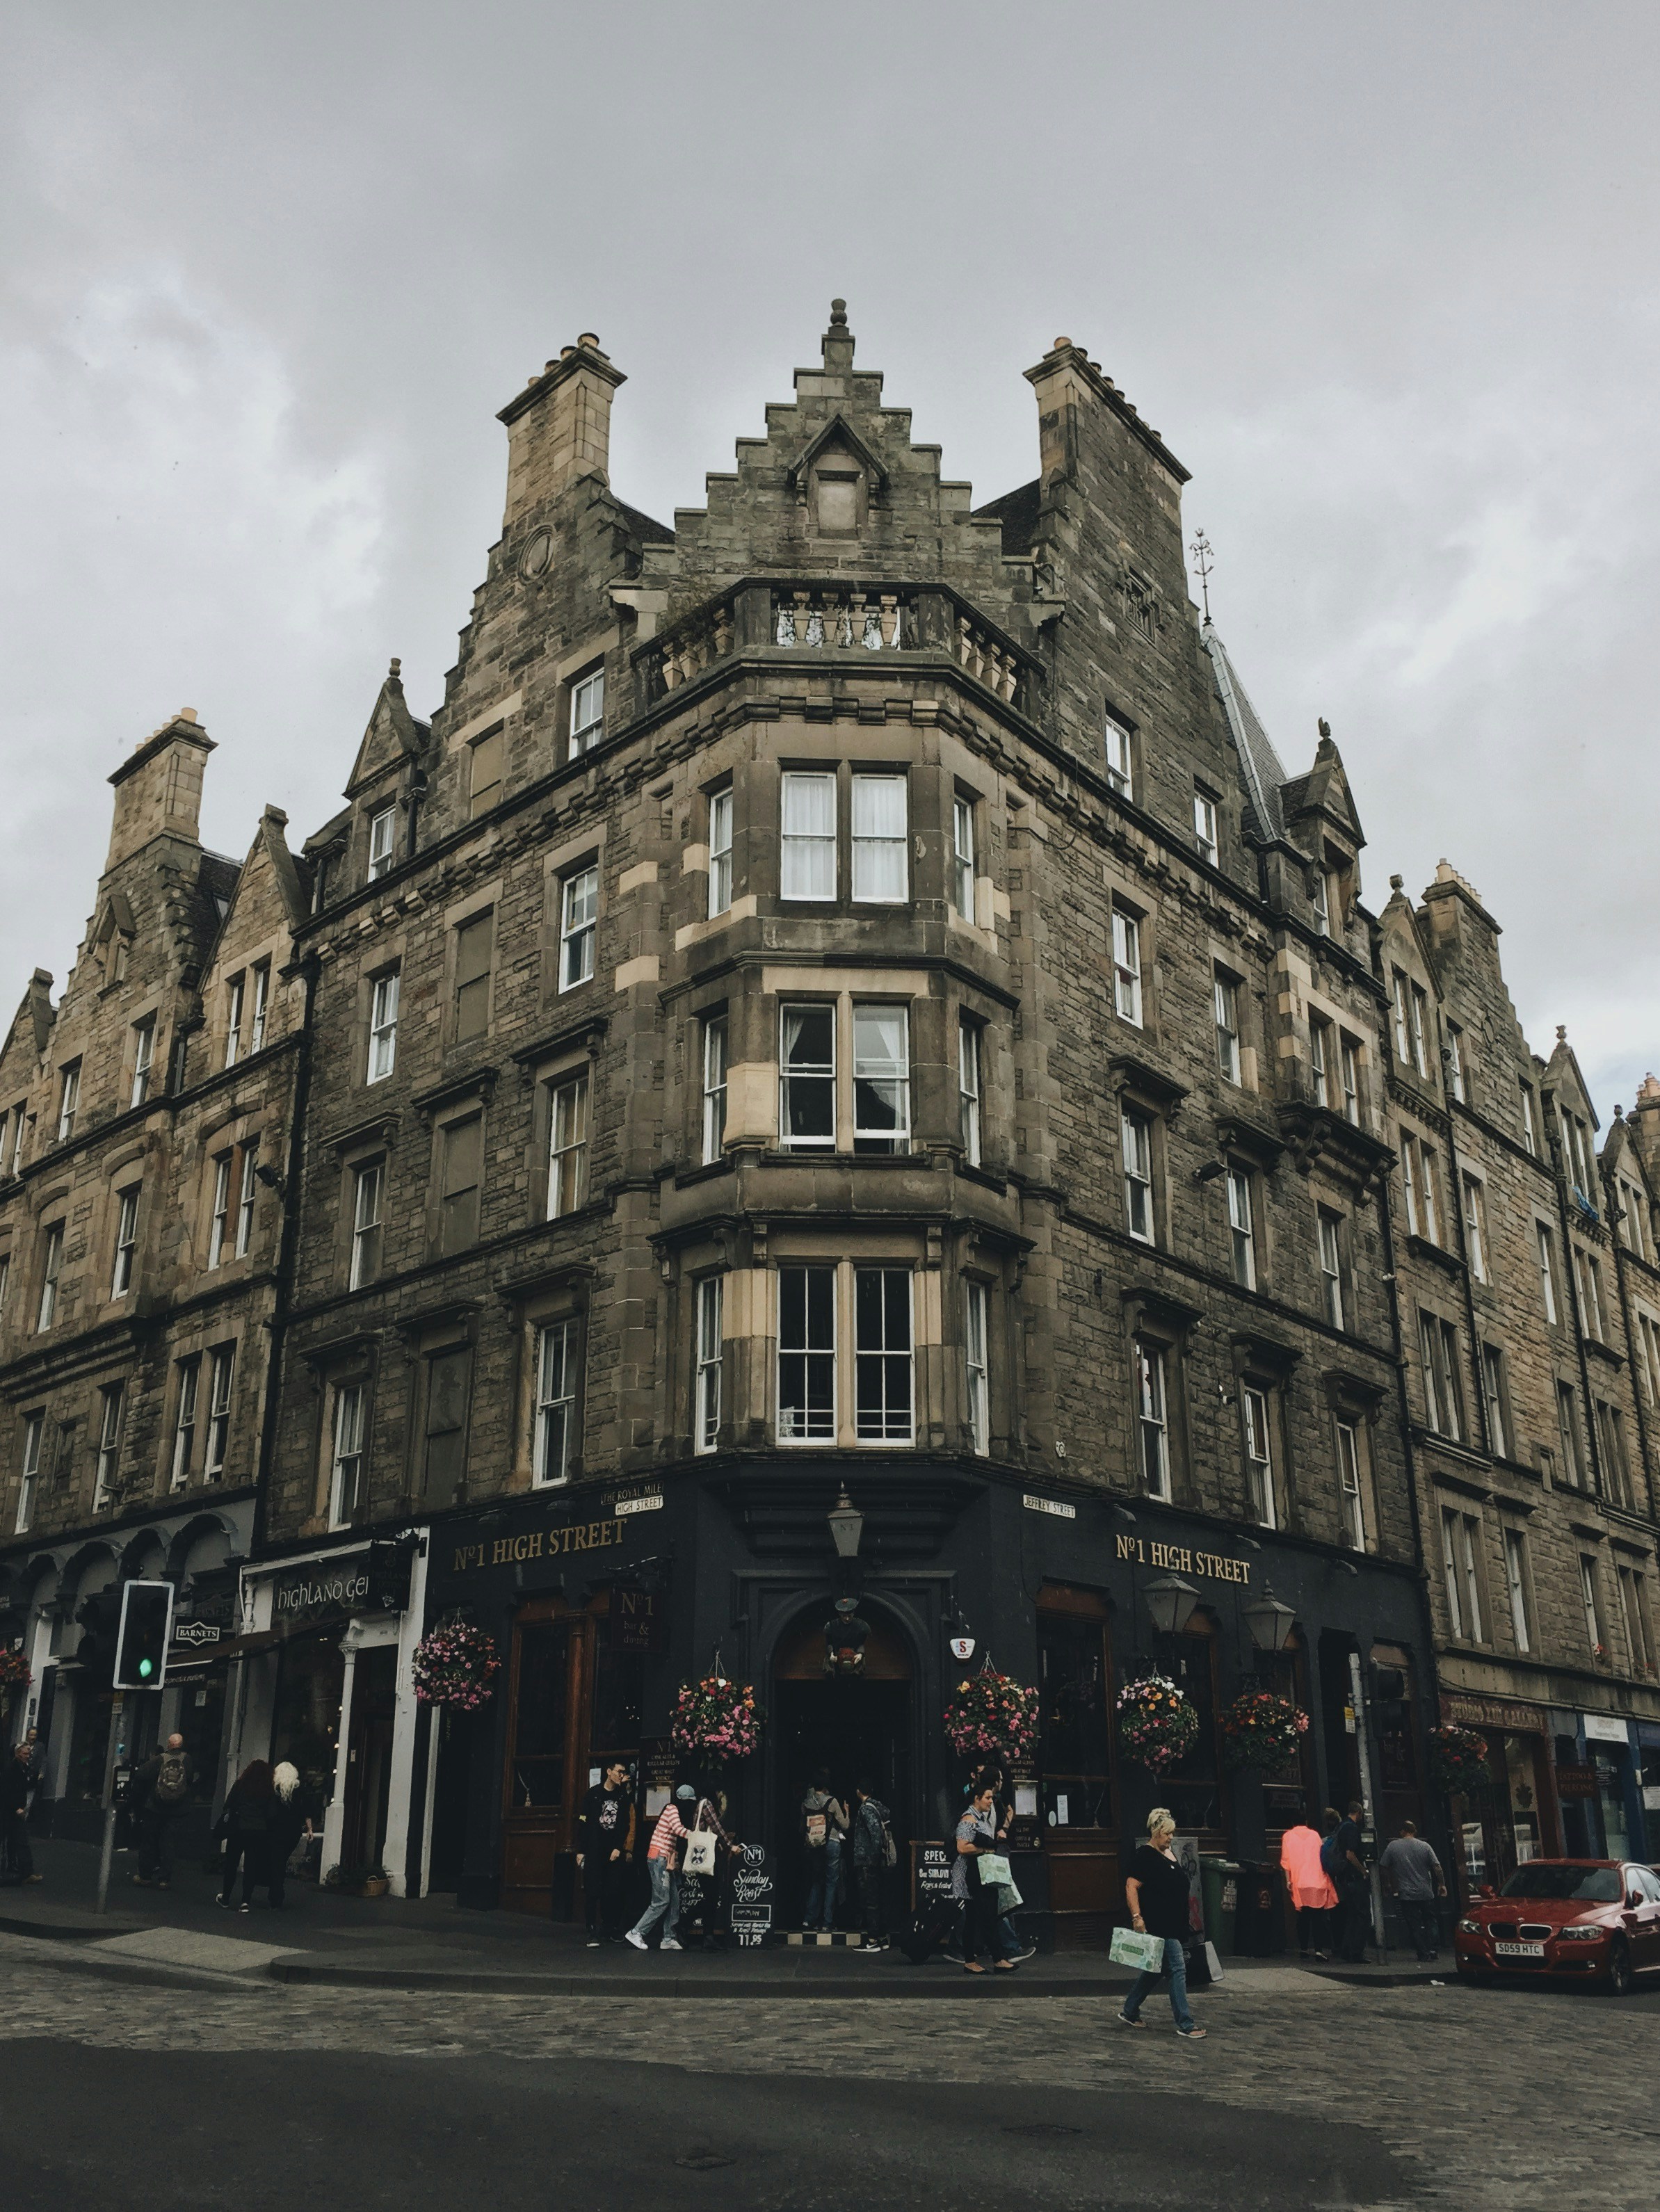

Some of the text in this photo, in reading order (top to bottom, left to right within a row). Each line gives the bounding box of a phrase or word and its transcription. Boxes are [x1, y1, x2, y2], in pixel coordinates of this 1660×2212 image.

[604, 1483, 662, 1503] THE ROYAL MILE
[617, 1496, 663, 1514] HIGH STREET
[1024, 1496, 1076, 1517] JEFFREY STREET
[492, 1532, 544, 1565] HIGH
[549, 1517, 629, 1556] STREET
[1151, 1542, 1193, 1573] HIGH
[1196, 1551, 1250, 1584] STREET
[179, 1629, 217, 1638] BARNETS
[624, 1620, 650, 1636] bar &
[1558, 1772, 1585, 1781] TATTOO
[1586, 1773, 1593, 1781] &
[1560, 1783, 1594, 1792] PIERCING
[924, 1850, 947, 1862] SPEC
[734, 1869, 773, 1891] Sunday
[735, 1884, 764, 1903] Roast
[738, 1934, 762, 1946] 11.95
[1499, 1944, 1540, 1954] SD59 HTC
